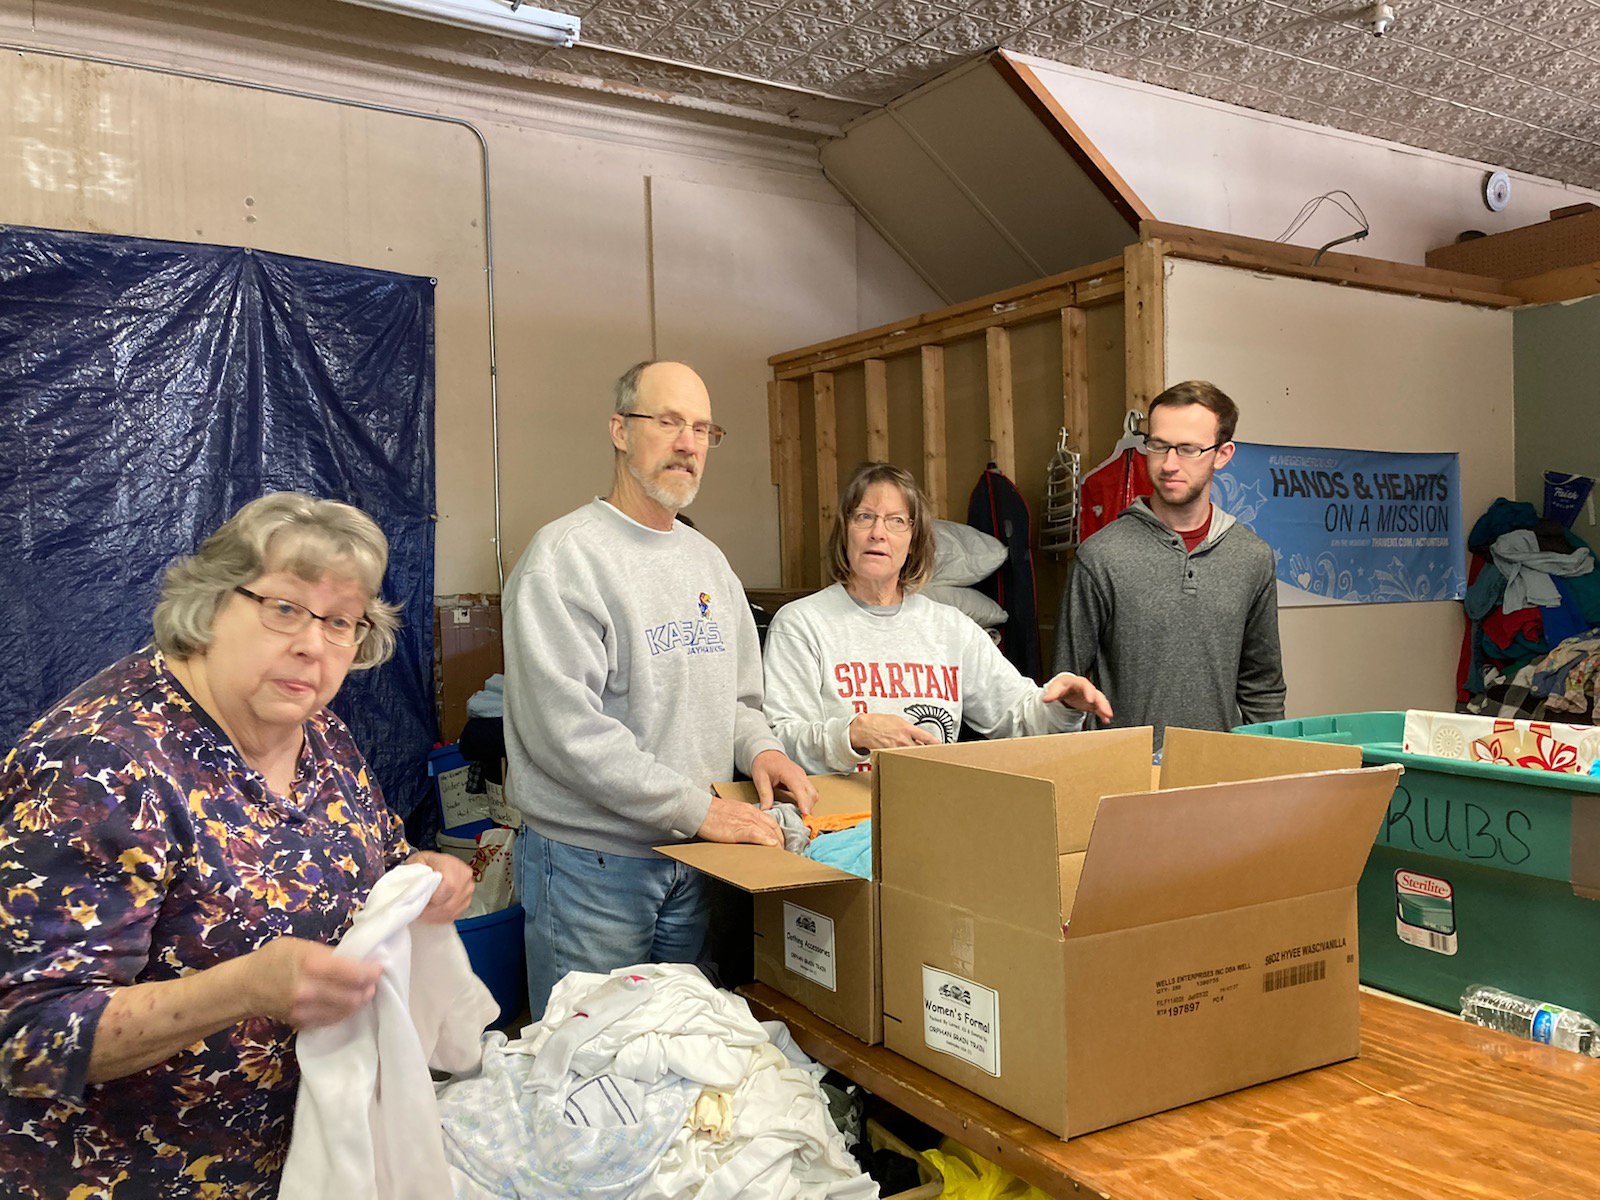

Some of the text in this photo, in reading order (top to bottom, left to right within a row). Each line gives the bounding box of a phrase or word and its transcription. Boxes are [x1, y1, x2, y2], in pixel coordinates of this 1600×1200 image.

[1270, 468, 1448, 501] HANDS & HEARTS
[1325, 503, 1448, 533] ON A MISSION
[834, 661, 959, 702] SPARTAN
[1402, 874, 1446, 895] Sterilite
[1281, 946, 1301, 961] HYVEE
[1155, 977, 1175, 988] WELLS
[1176, 970, 1214, 983] ENTERPRISES
[1214, 968, 1224, 976] INC
[1237, 963, 1251, 971] WELL
[924, 998, 962, 1021] Women's
[964, 1012, 990, 1034] Formal
[1168, 1001, 1200, 1017] 197897
